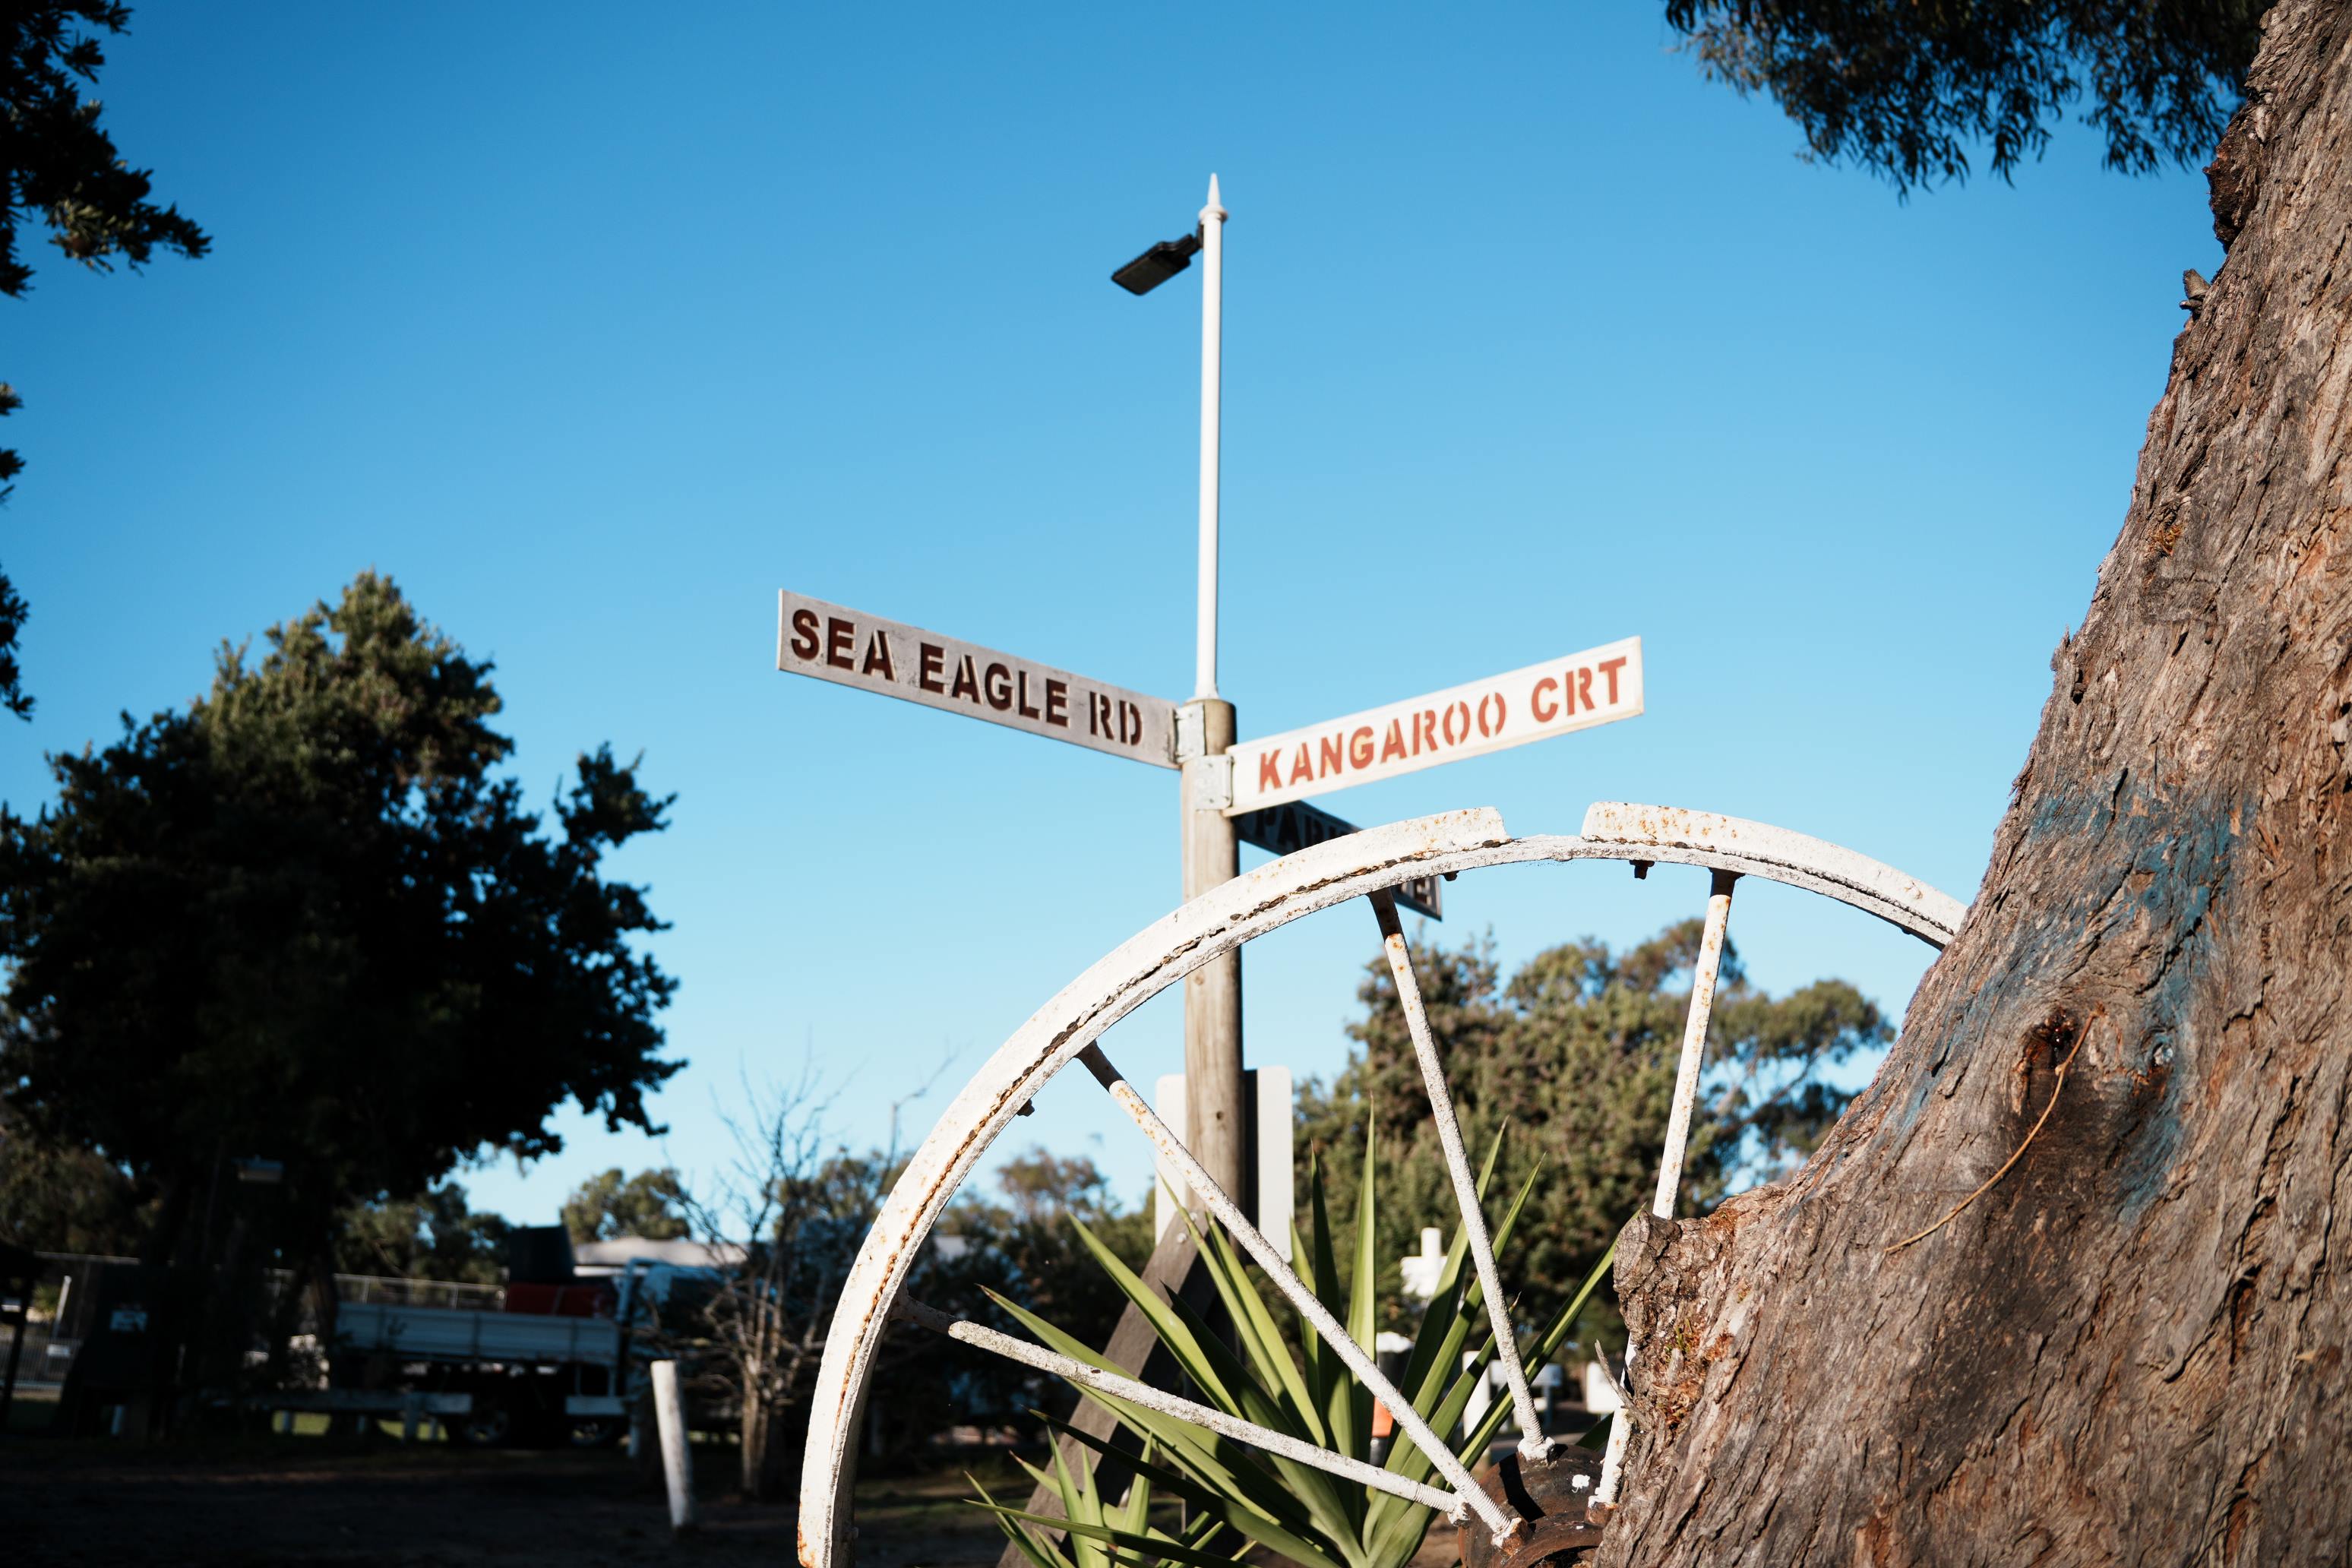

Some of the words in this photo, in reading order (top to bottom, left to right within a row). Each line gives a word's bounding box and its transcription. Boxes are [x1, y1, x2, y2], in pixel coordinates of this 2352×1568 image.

[790, 609, 896, 682] SEA
[919, 642, 1070, 729] EAGLE
[1089, 691, 1145, 747] RD
[1259, 691, 1506, 793] KANGAROO
[1531, 656, 1627, 722] CRT
